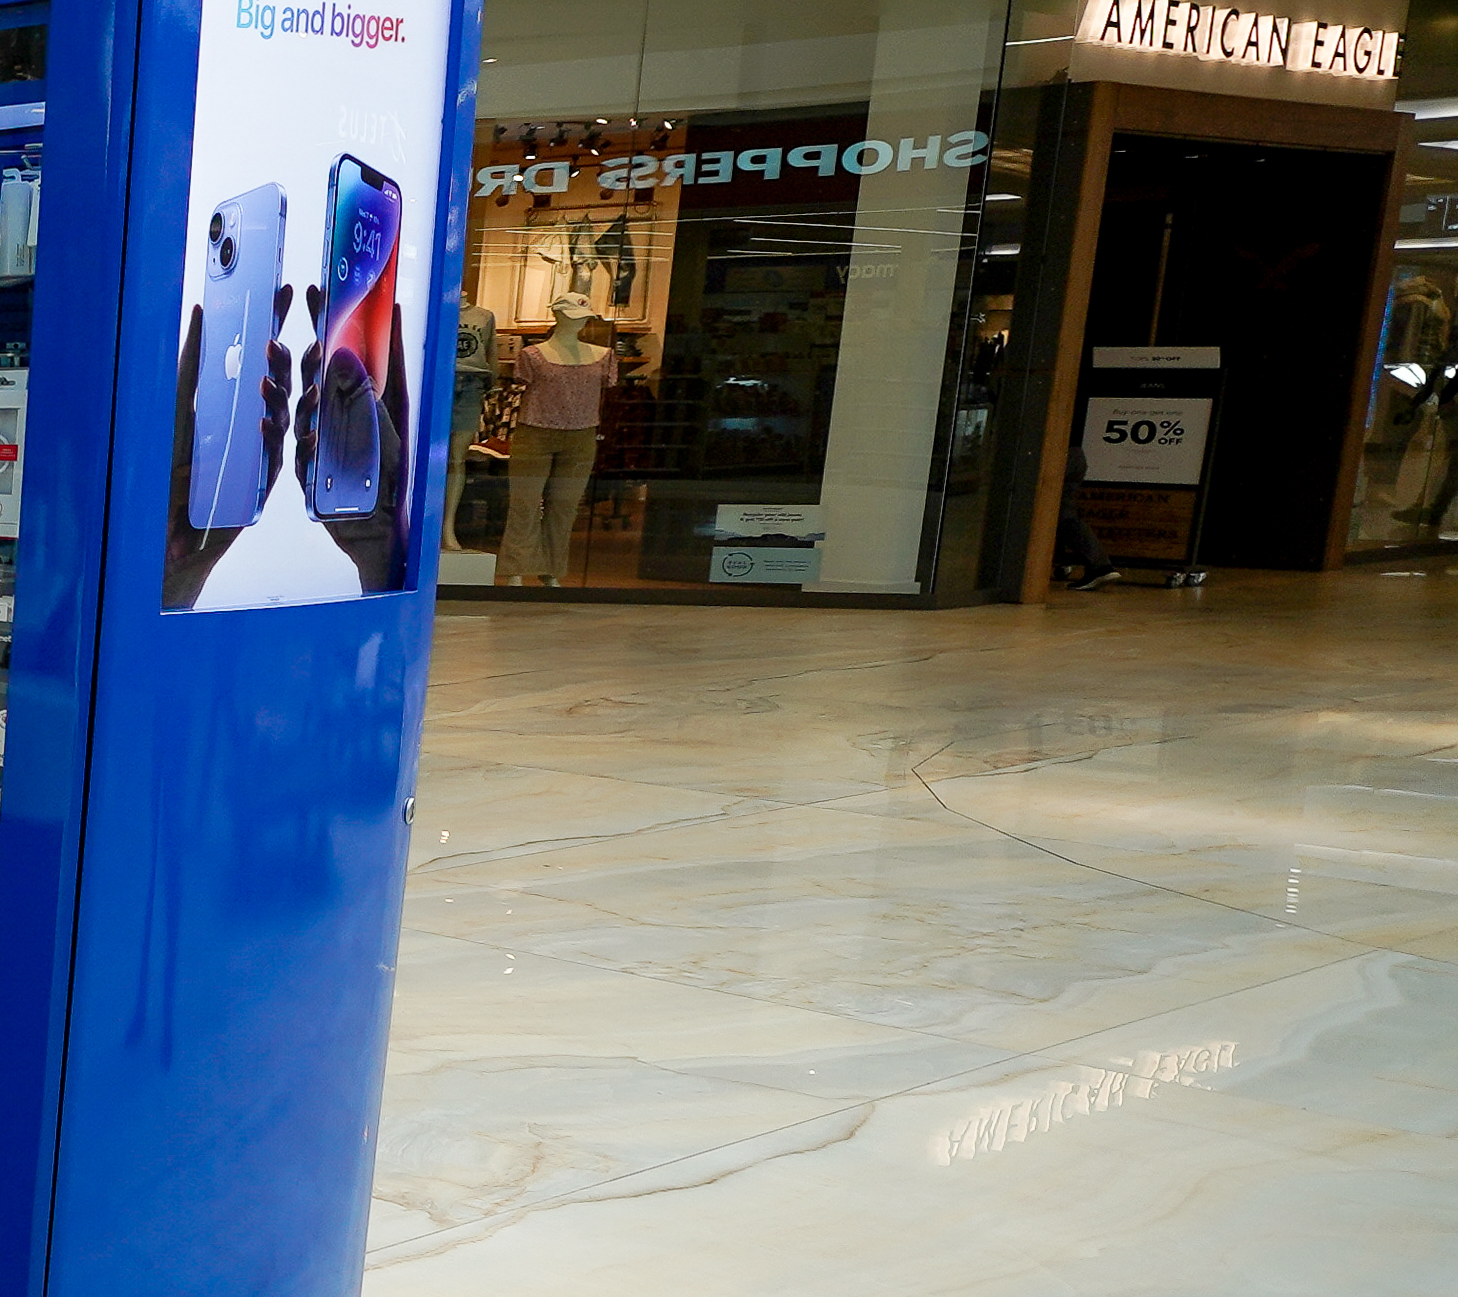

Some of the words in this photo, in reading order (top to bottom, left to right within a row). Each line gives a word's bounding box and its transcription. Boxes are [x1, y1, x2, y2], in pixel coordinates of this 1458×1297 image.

[281, 2, 325, 35] and
[330, 3, 405, 49] bigger.
[352, 222, 382, 261] 9:41
[1102, 419, 1185, 445] 50%
[1158, 437, 1183, 446] OFF
